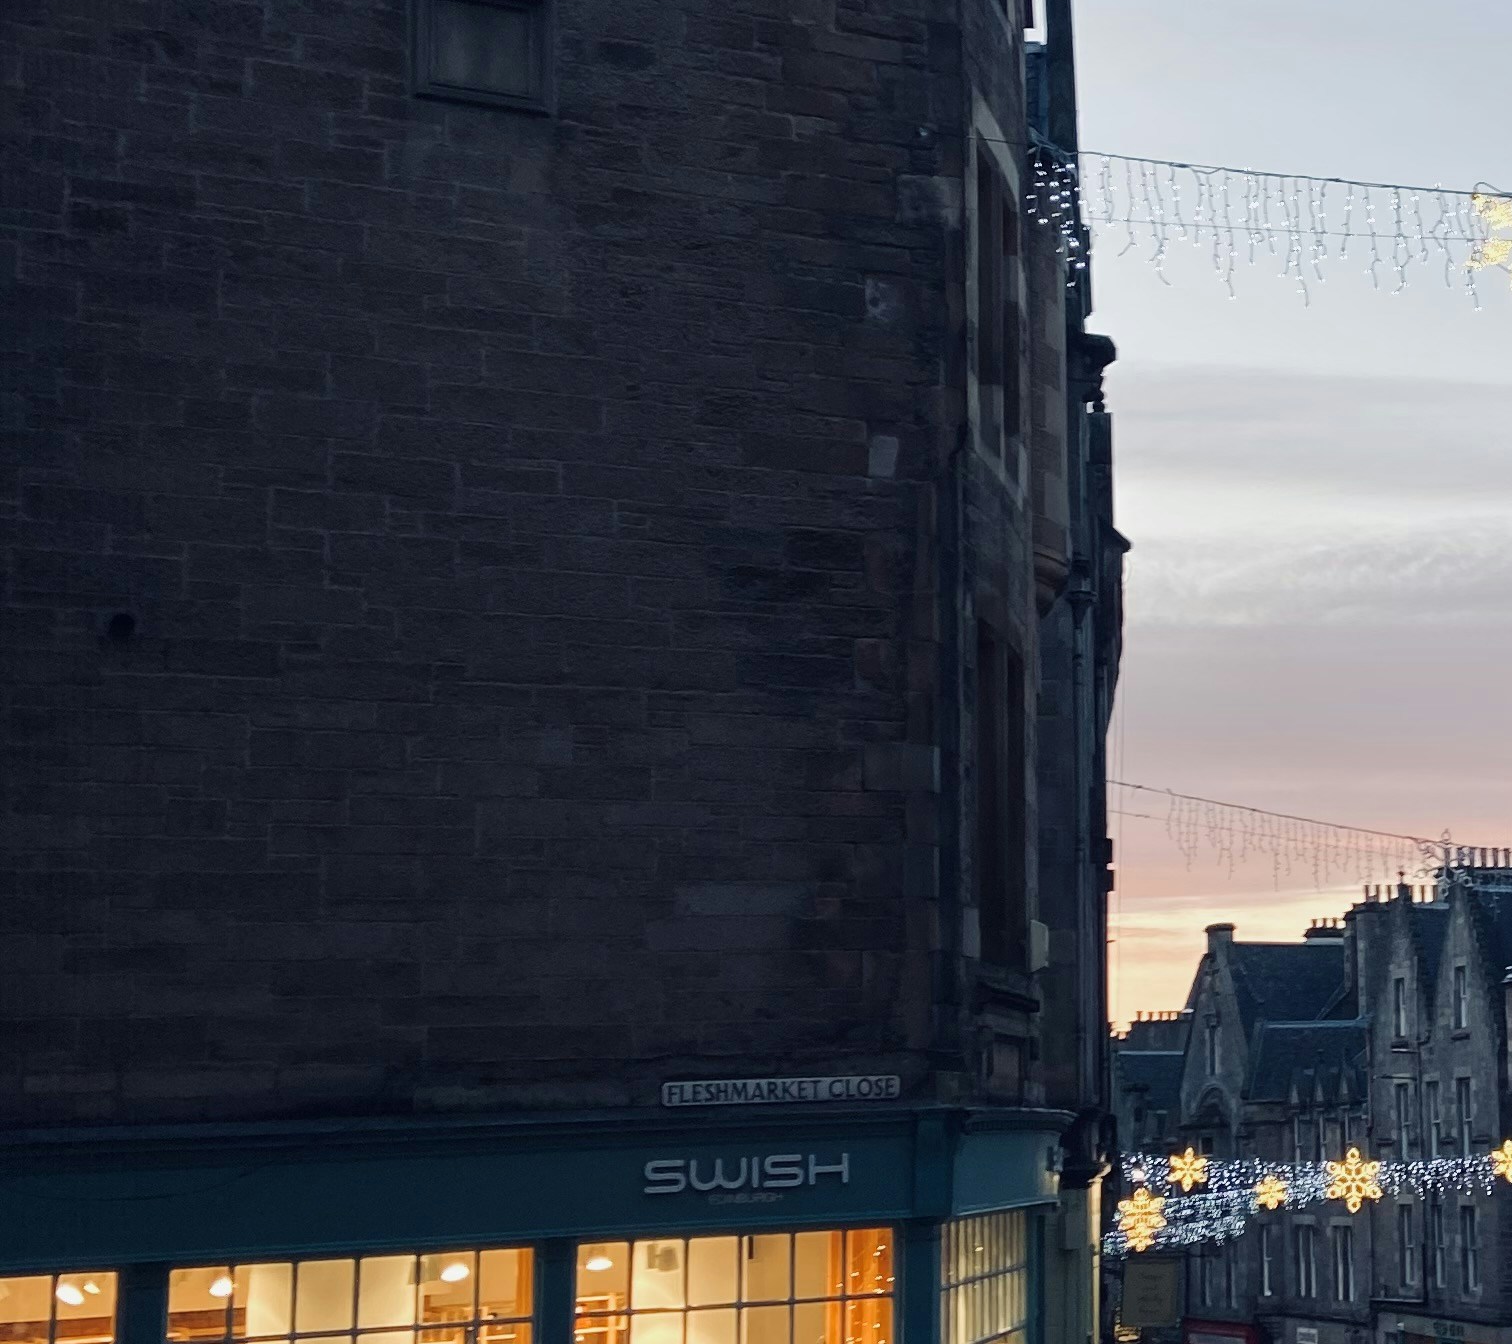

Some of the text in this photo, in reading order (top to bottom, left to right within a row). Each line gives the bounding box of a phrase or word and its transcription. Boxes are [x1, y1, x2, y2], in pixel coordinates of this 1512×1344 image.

[667, 1077, 896, 1104] FLESHMARKET CLOSE
[644, 1153, 849, 1194] SWISH
